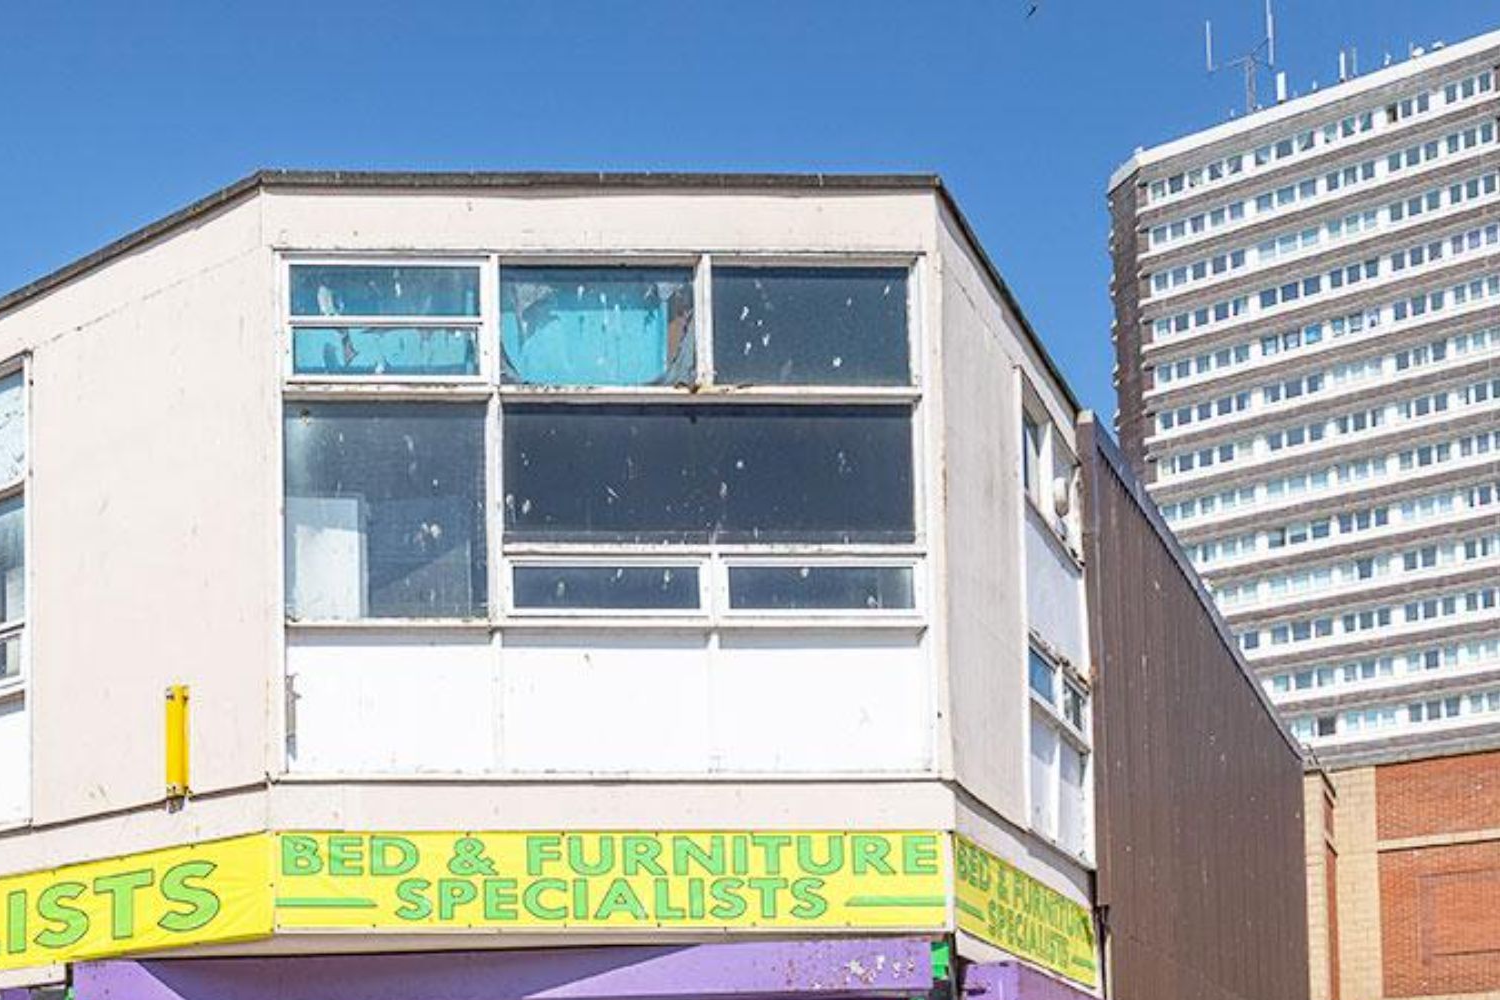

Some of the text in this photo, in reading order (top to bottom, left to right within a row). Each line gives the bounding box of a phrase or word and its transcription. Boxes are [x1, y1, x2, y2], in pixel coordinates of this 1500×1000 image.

[279, 834, 939, 877] BED & FURNITURE
[957, 846, 991, 892] BED
[394, 877, 828, 920] SPECIALISTS
